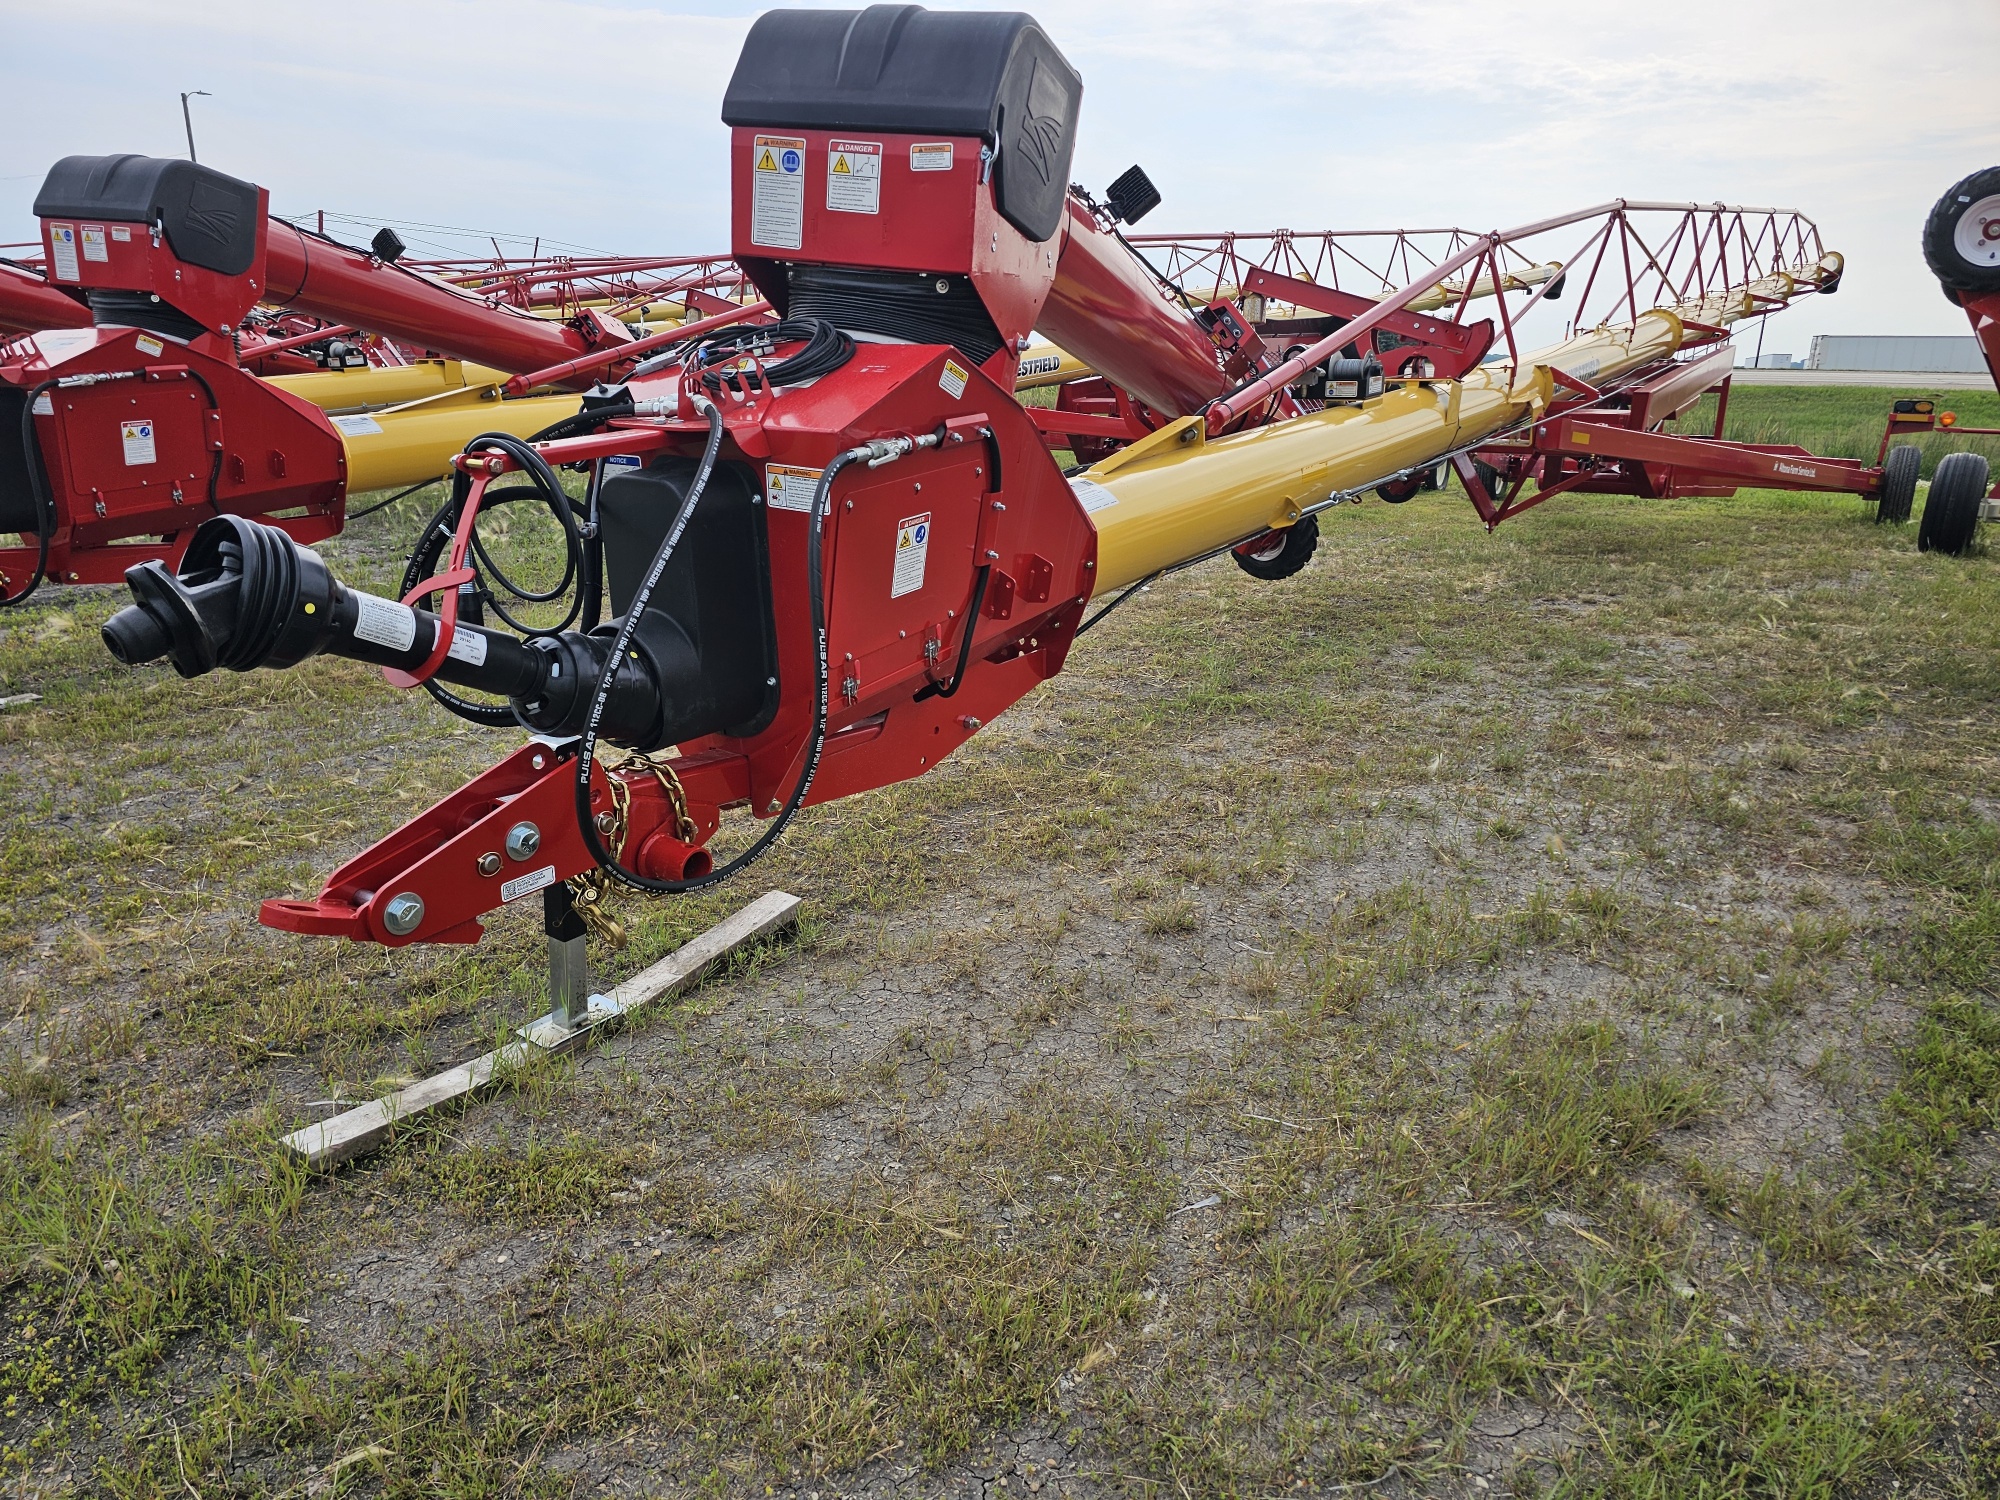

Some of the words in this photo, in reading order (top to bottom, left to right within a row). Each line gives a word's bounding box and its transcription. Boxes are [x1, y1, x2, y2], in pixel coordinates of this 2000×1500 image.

[1017, 356, 1060, 376] STFIELD
[701, 465, 712, 482] HARC
[696, 481, 706, 493] 2SC
[683, 495, 698, 518] 100R19
[909, 517, 925, 526] DANGER
[669, 520, 686, 546] 100R16
[662, 545, 673, 560] SAE
[647, 559, 666, 588] EXCEEDS
[640, 588, 651, 602] WP
[633, 602, 645, 617] BAR
[629, 617, 638, 632] 275
[618, 637, 629, 651] PSI
[610, 650, 623, 670] 4000
[819, 628, 828, 678] PULSAR
[602, 673, 613, 689] 1/2"
[590, 692, 607, 728] 112CC-08
[581, 731, 595, 784] PULSAR
